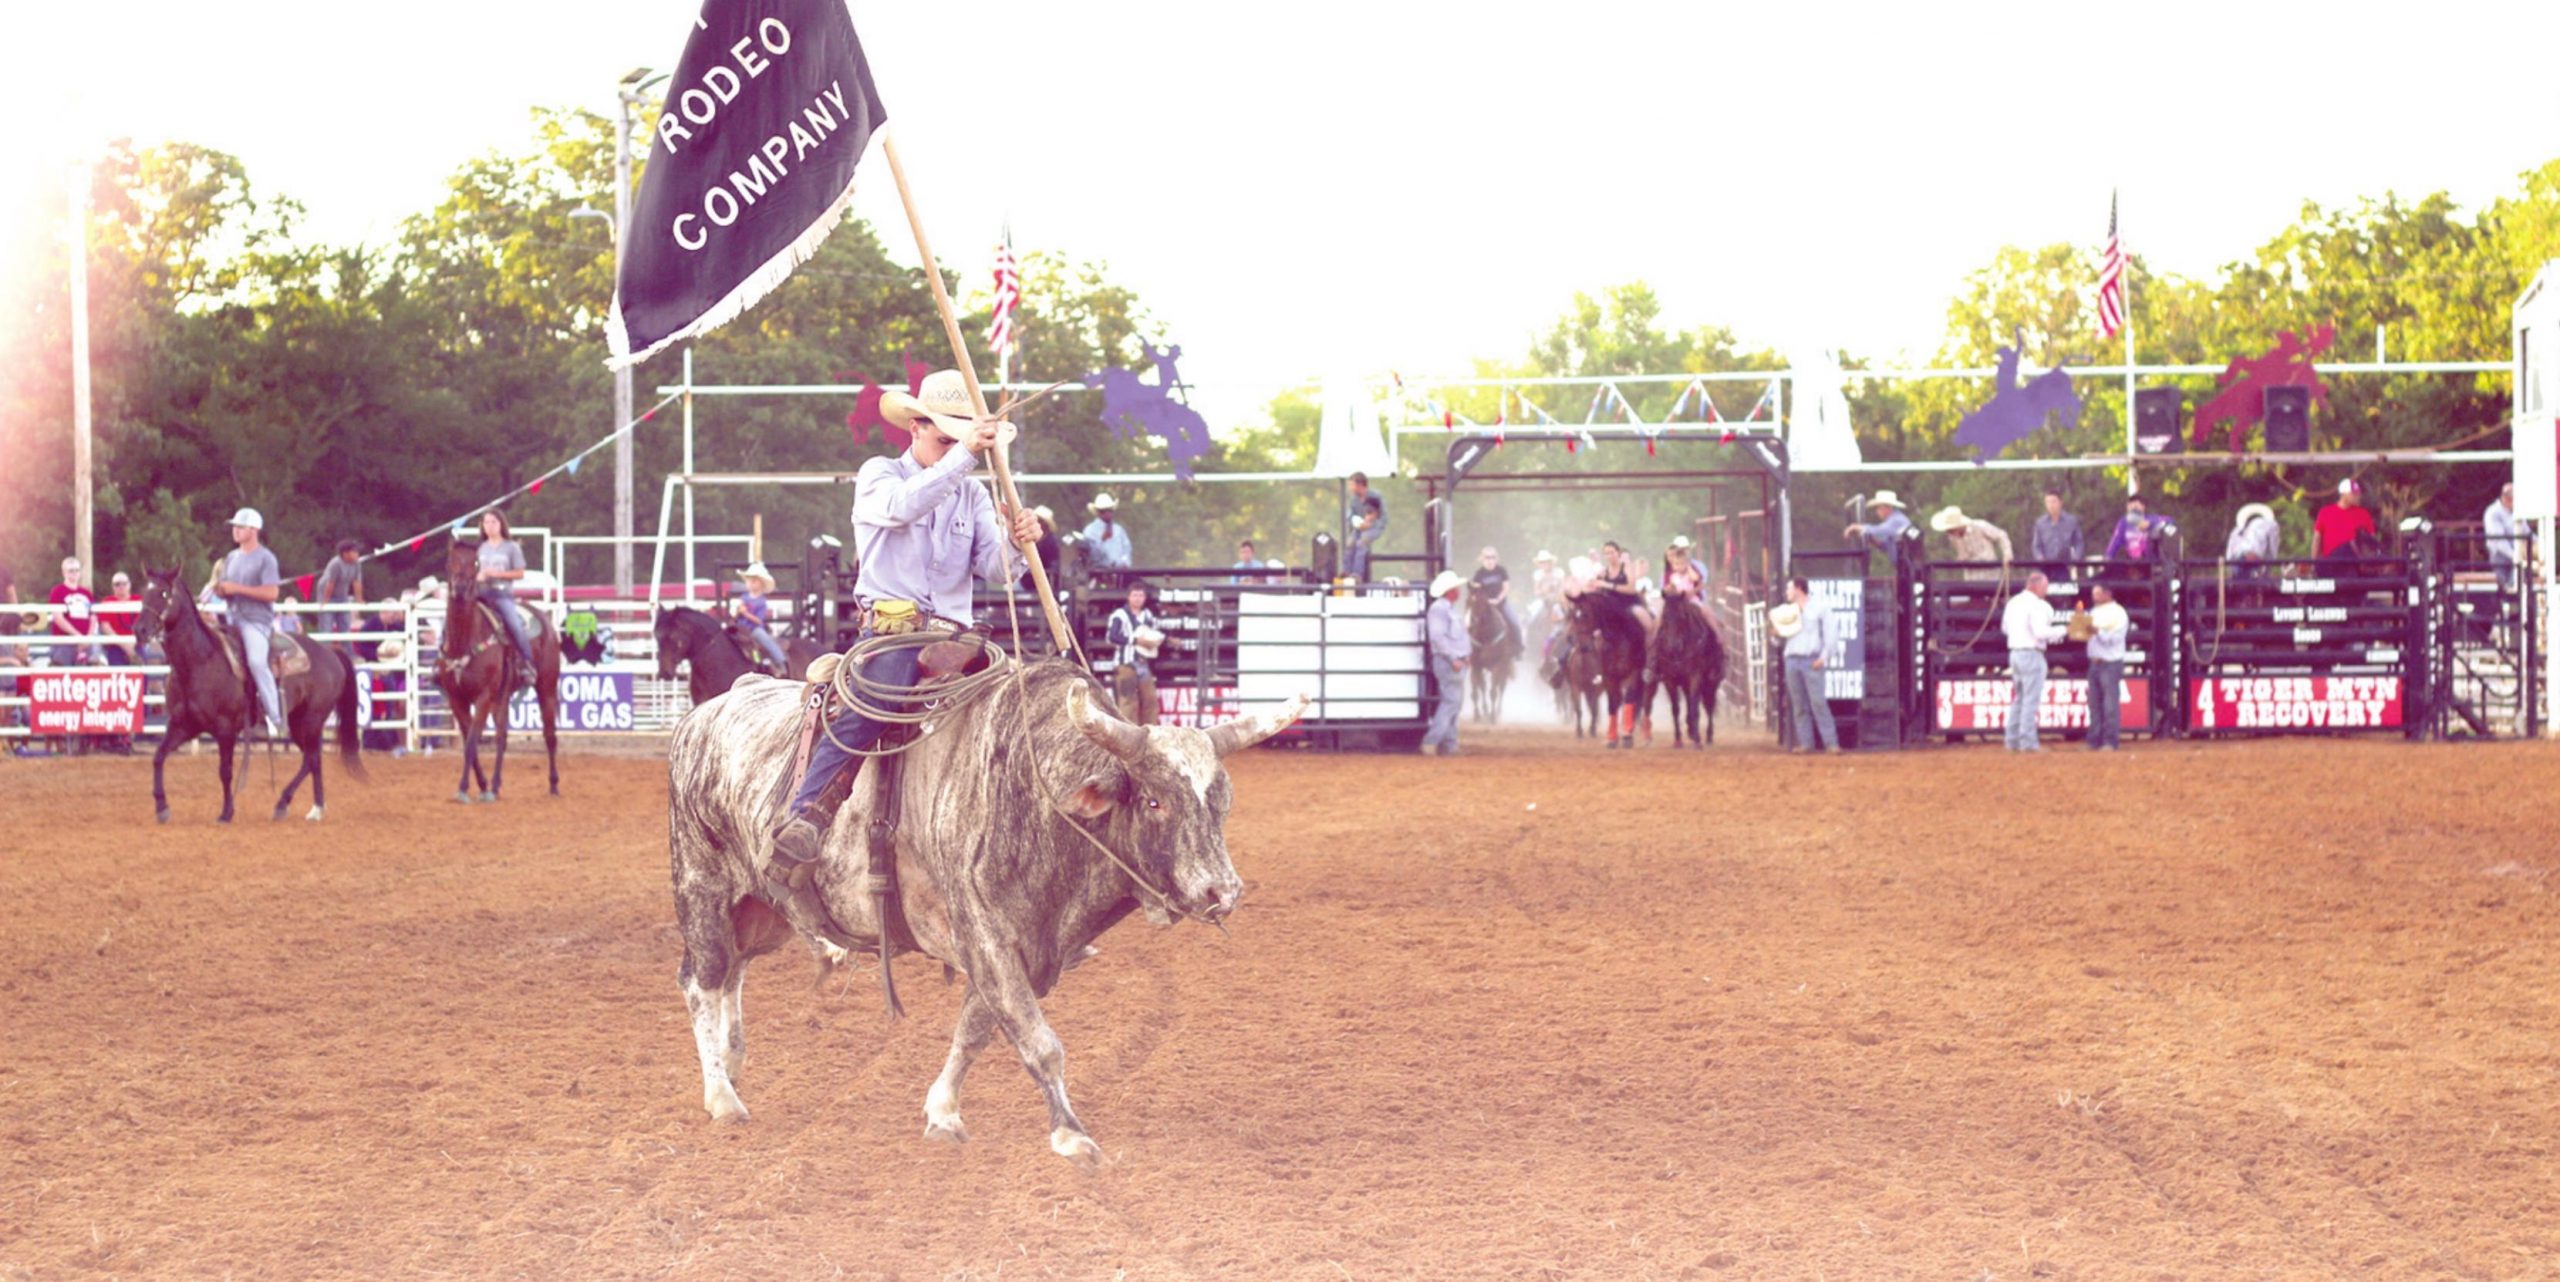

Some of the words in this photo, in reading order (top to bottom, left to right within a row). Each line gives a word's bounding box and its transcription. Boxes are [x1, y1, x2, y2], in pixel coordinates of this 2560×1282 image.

[658, 17, 791, 154] RODEO
[672, 80, 850, 250] COMPANY
[33, 673, 141, 709] entegrity
[2220, 678, 2314, 702] TIGER
[2326, 677, 2398, 701] MTN
[38, 711, 80, 731] energy
[82, 706, 134, 731] integrity
[580, 702, 632, 728] GAS
[2236, 700, 2386, 727] RECOVERY
